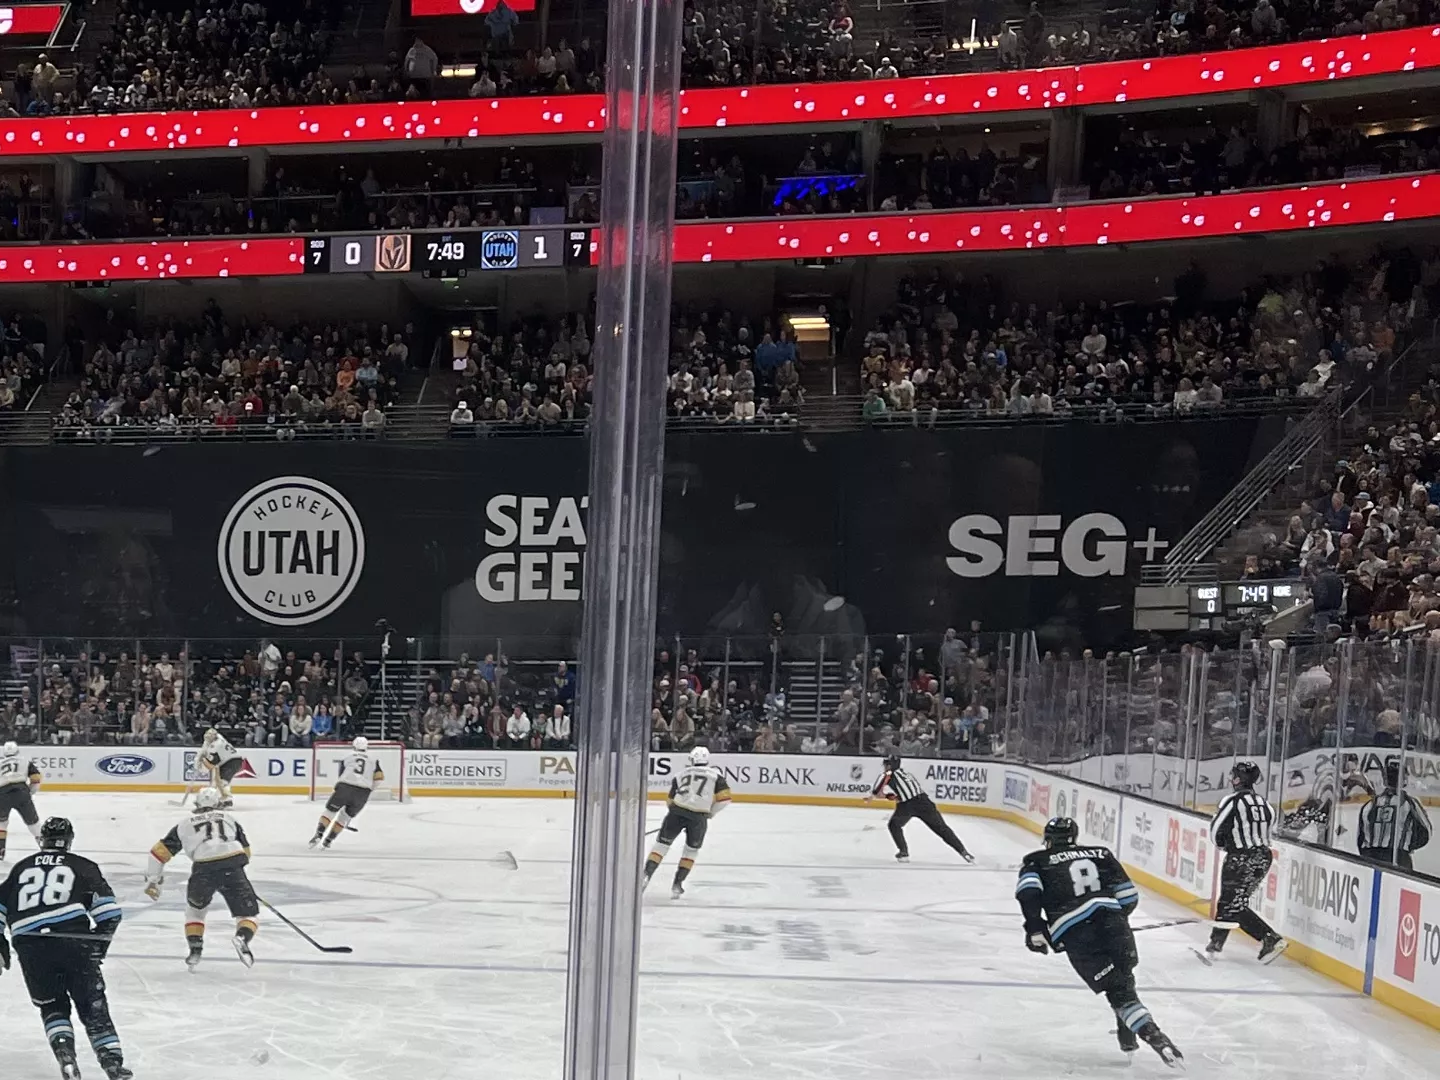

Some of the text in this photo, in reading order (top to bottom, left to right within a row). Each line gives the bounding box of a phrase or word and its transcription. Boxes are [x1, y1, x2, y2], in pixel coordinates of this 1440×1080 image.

[345, 242, 360, 265] 0
[427, 242, 464, 261] 7:49
[486, 242, 514, 257] UTAH
[533, 236, 548, 259] 1
[573, 244, 582, 257] 7
[313, 252, 322, 265] 7
[253, 495, 334, 521] HOCKEY
[243, 530, 340, 577] UTAH
[475, 552, 587, 603] GEE
[264, 589, 317, 607] CLUB
[1238, 585, 1268, 603] 7:49
[32, 757, 77, 770] ESERT
[107, 757, 144, 773] Ford
[268, 759, 345, 778] DELT
[408, 754, 439, 764] JUST
[539, 756, 575, 775] PA
[408, 765, 503, 778] INGREDIENTS
[759, 766, 817, 786] BANK
[925, 764, 988, 784] AMERICAN
[679, 774, 709, 798] 27
[34, 854, 65, 867] COLE
[1048, 847, 1106, 865] SCHMALTZ
[17, 866, 76, 912] 28
